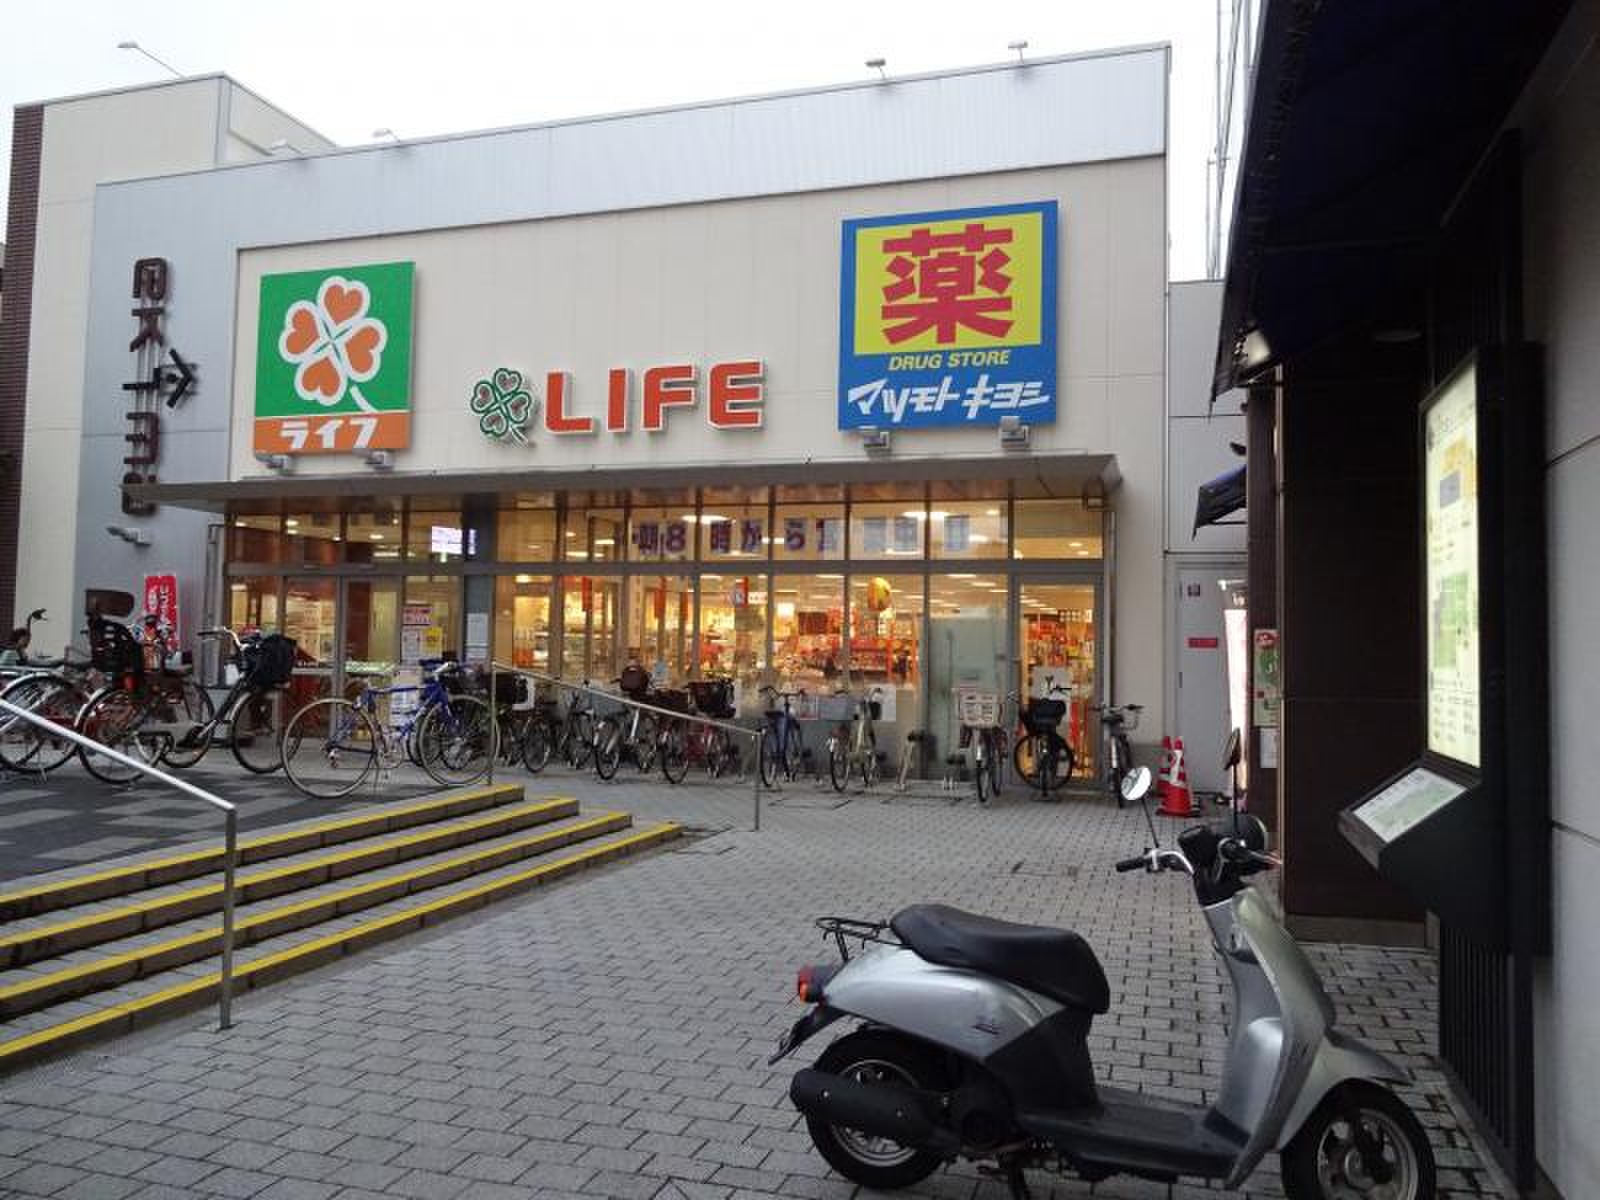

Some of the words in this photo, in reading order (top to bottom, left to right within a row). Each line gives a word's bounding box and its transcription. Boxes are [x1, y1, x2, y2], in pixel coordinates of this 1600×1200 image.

[881, 223, 1015, 346] 薬
[888, 354, 943, 372] DRUG
[947, 349, 1011, 369] STORE
[544, 361, 763, 434] LIFE
[847, 373, 1051, 423] マツモトキヨシ
[279, 417, 379, 450] ライフ
